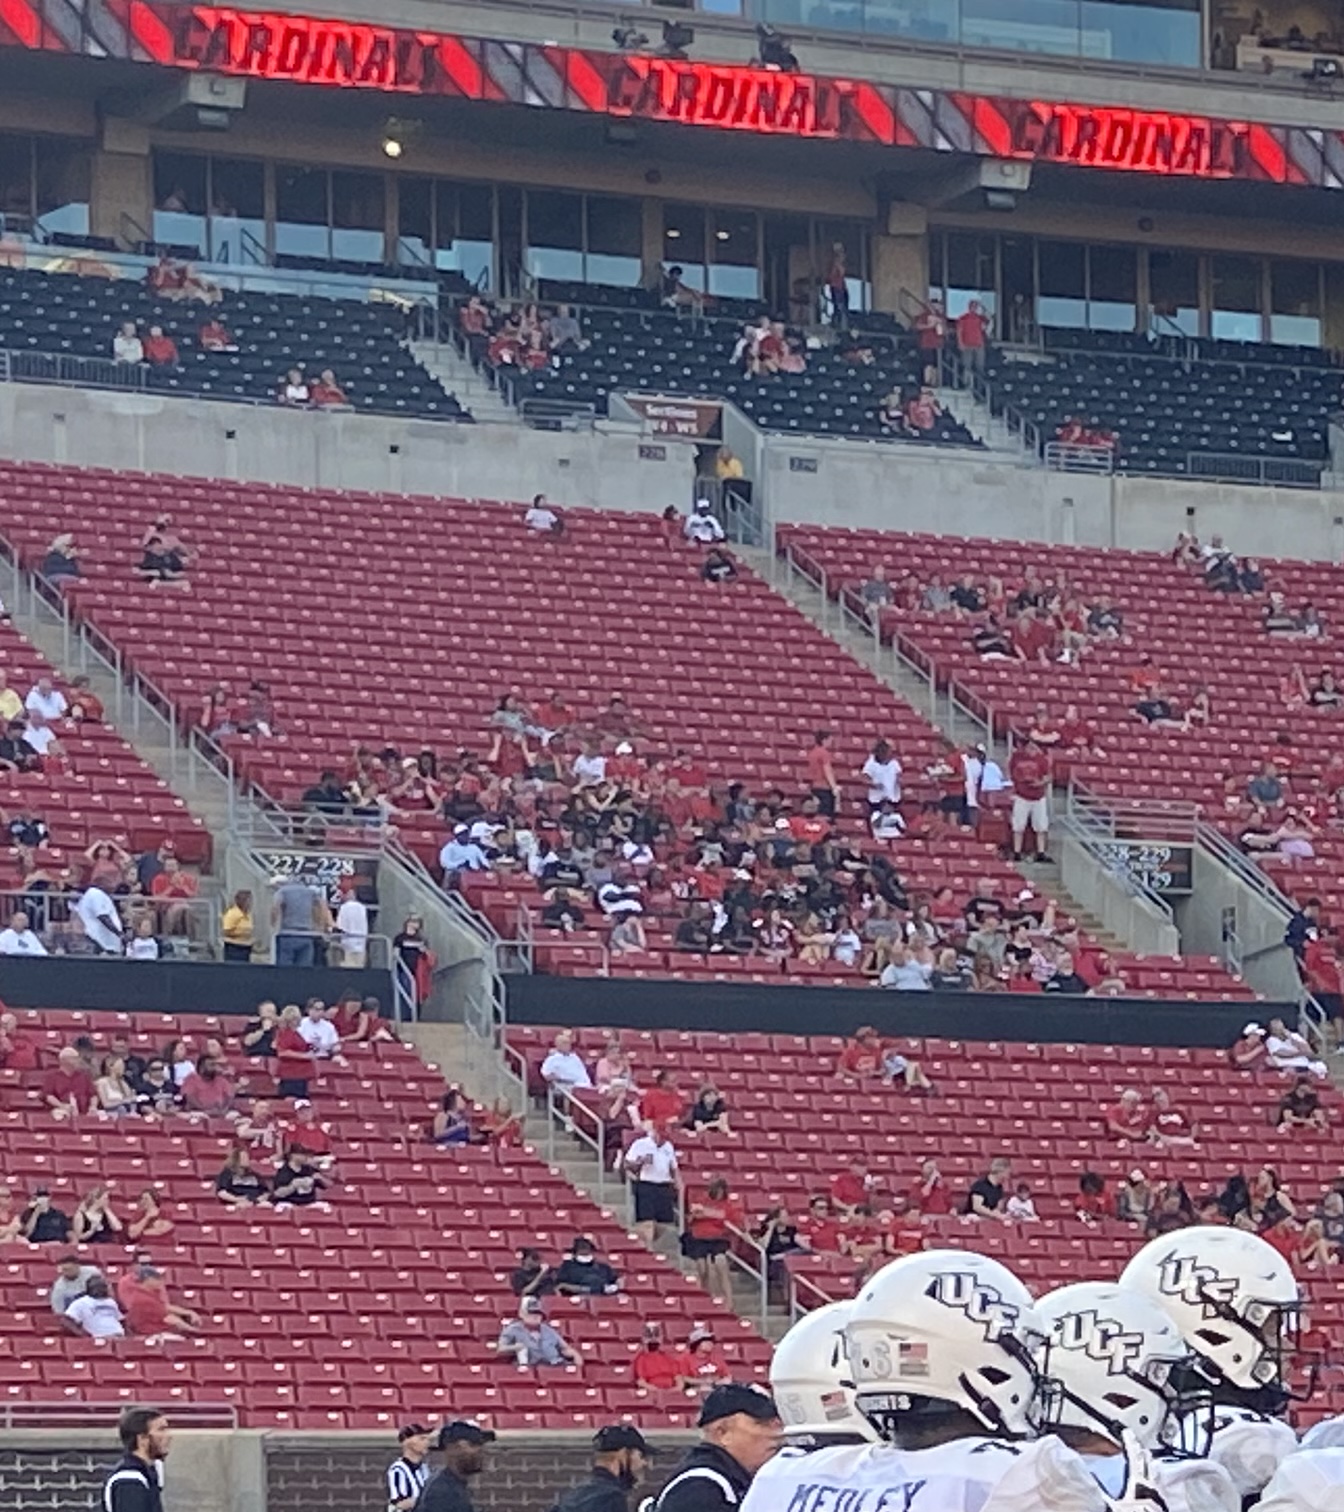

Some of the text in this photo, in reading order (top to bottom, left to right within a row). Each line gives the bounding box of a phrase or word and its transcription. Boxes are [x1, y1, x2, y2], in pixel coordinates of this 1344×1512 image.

[925, 1272, 1020, 1343] UCF
[1157, 1250, 1239, 1320] UCF
[1053, 1309, 1144, 1377] UCF
